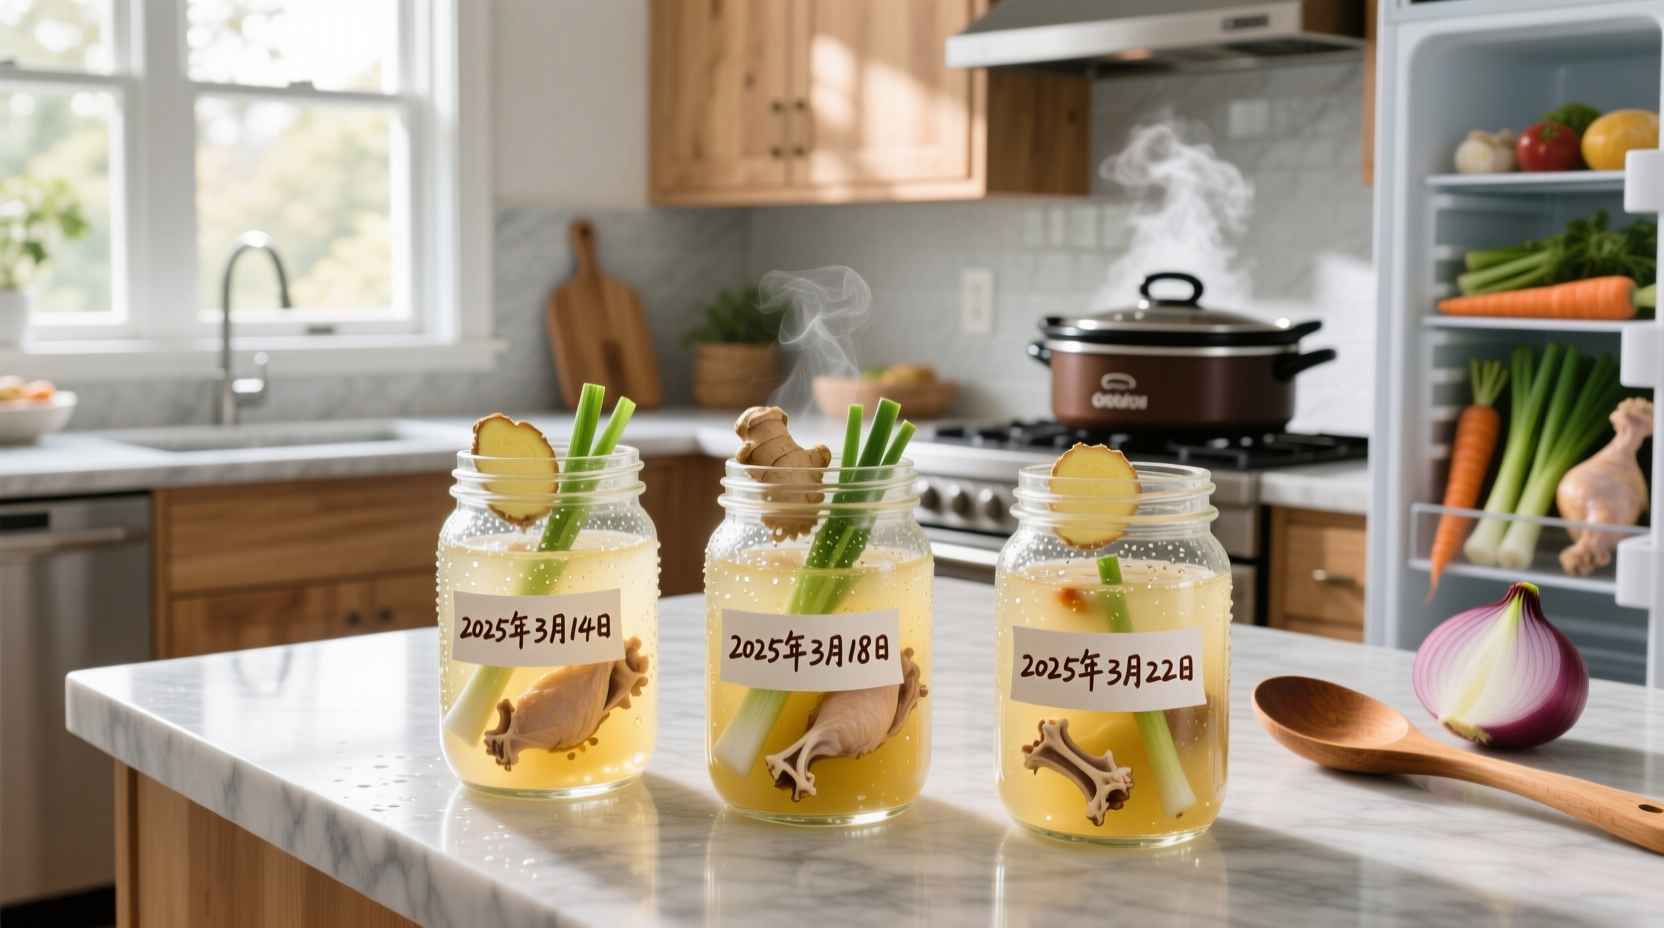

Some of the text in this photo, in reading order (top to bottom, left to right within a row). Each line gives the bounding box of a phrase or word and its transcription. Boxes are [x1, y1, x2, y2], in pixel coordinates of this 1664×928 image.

[460, 611, 611, 650] 2025年3月14日
[729, 630, 889, 673] 2025年3月18日
[1020, 649, 1193, 692] 2025年3月22日
